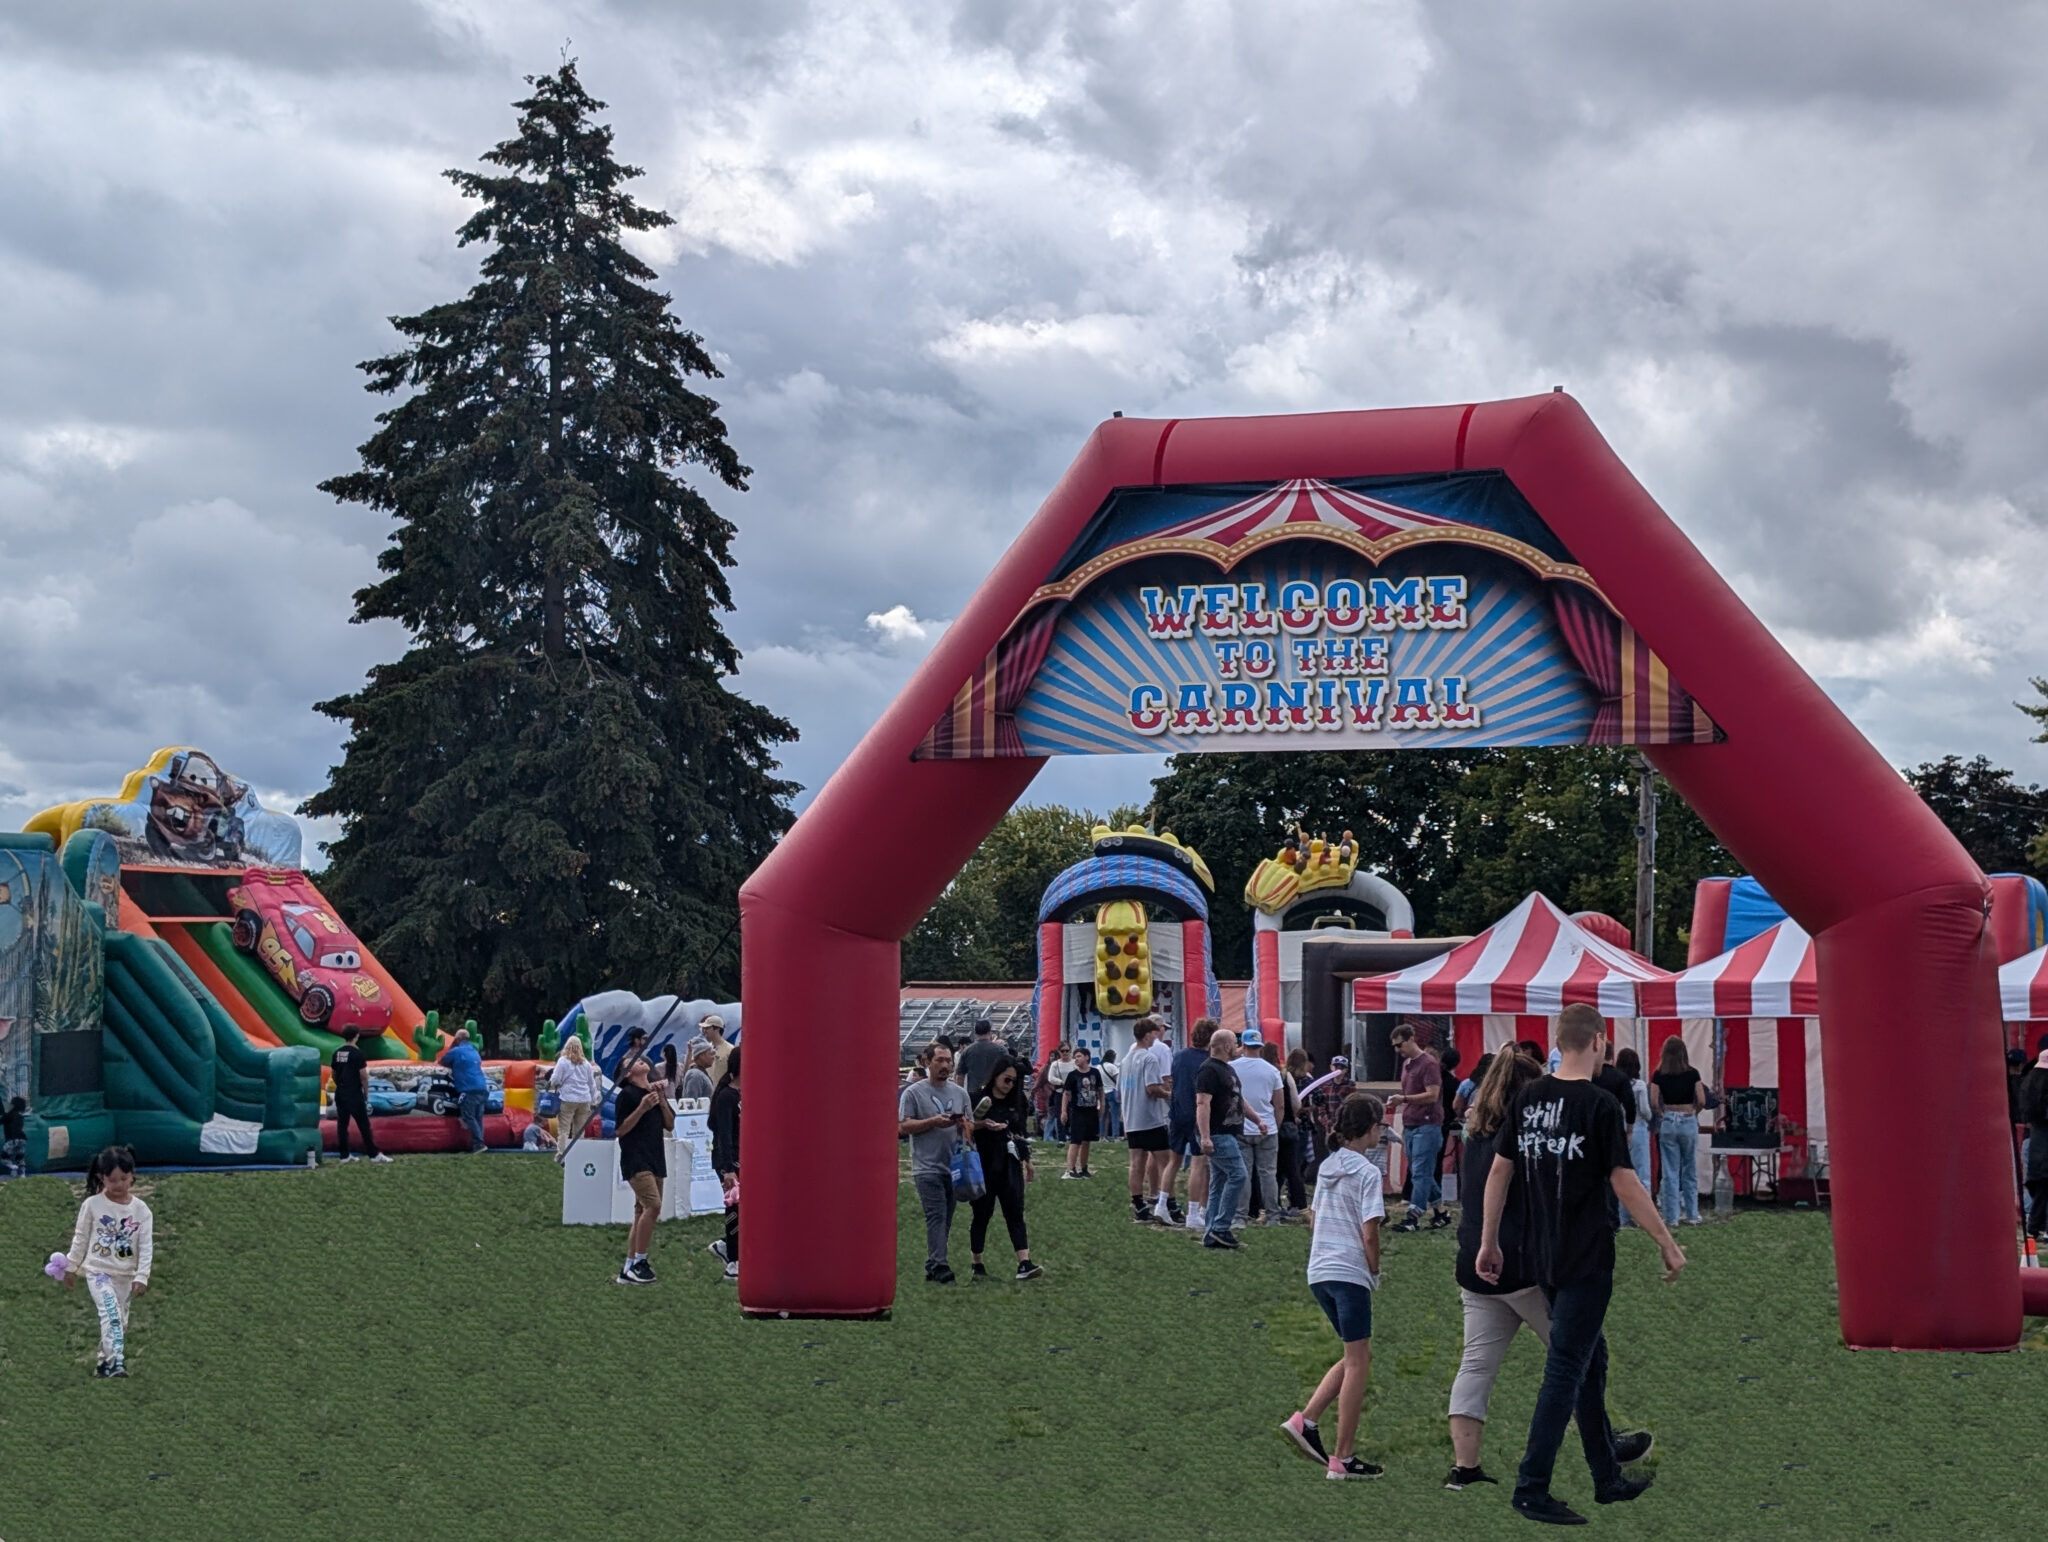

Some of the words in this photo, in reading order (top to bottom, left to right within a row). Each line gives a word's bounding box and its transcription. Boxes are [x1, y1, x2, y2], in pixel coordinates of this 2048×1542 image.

[1141, 576, 1467, 639] WELCOME
[1215, 640, 1275, 679] TO
[1292, 637, 1388, 676] THE
[1127, 676, 1479, 736] CARNIVAL
[260, 937, 293, 972] 95
